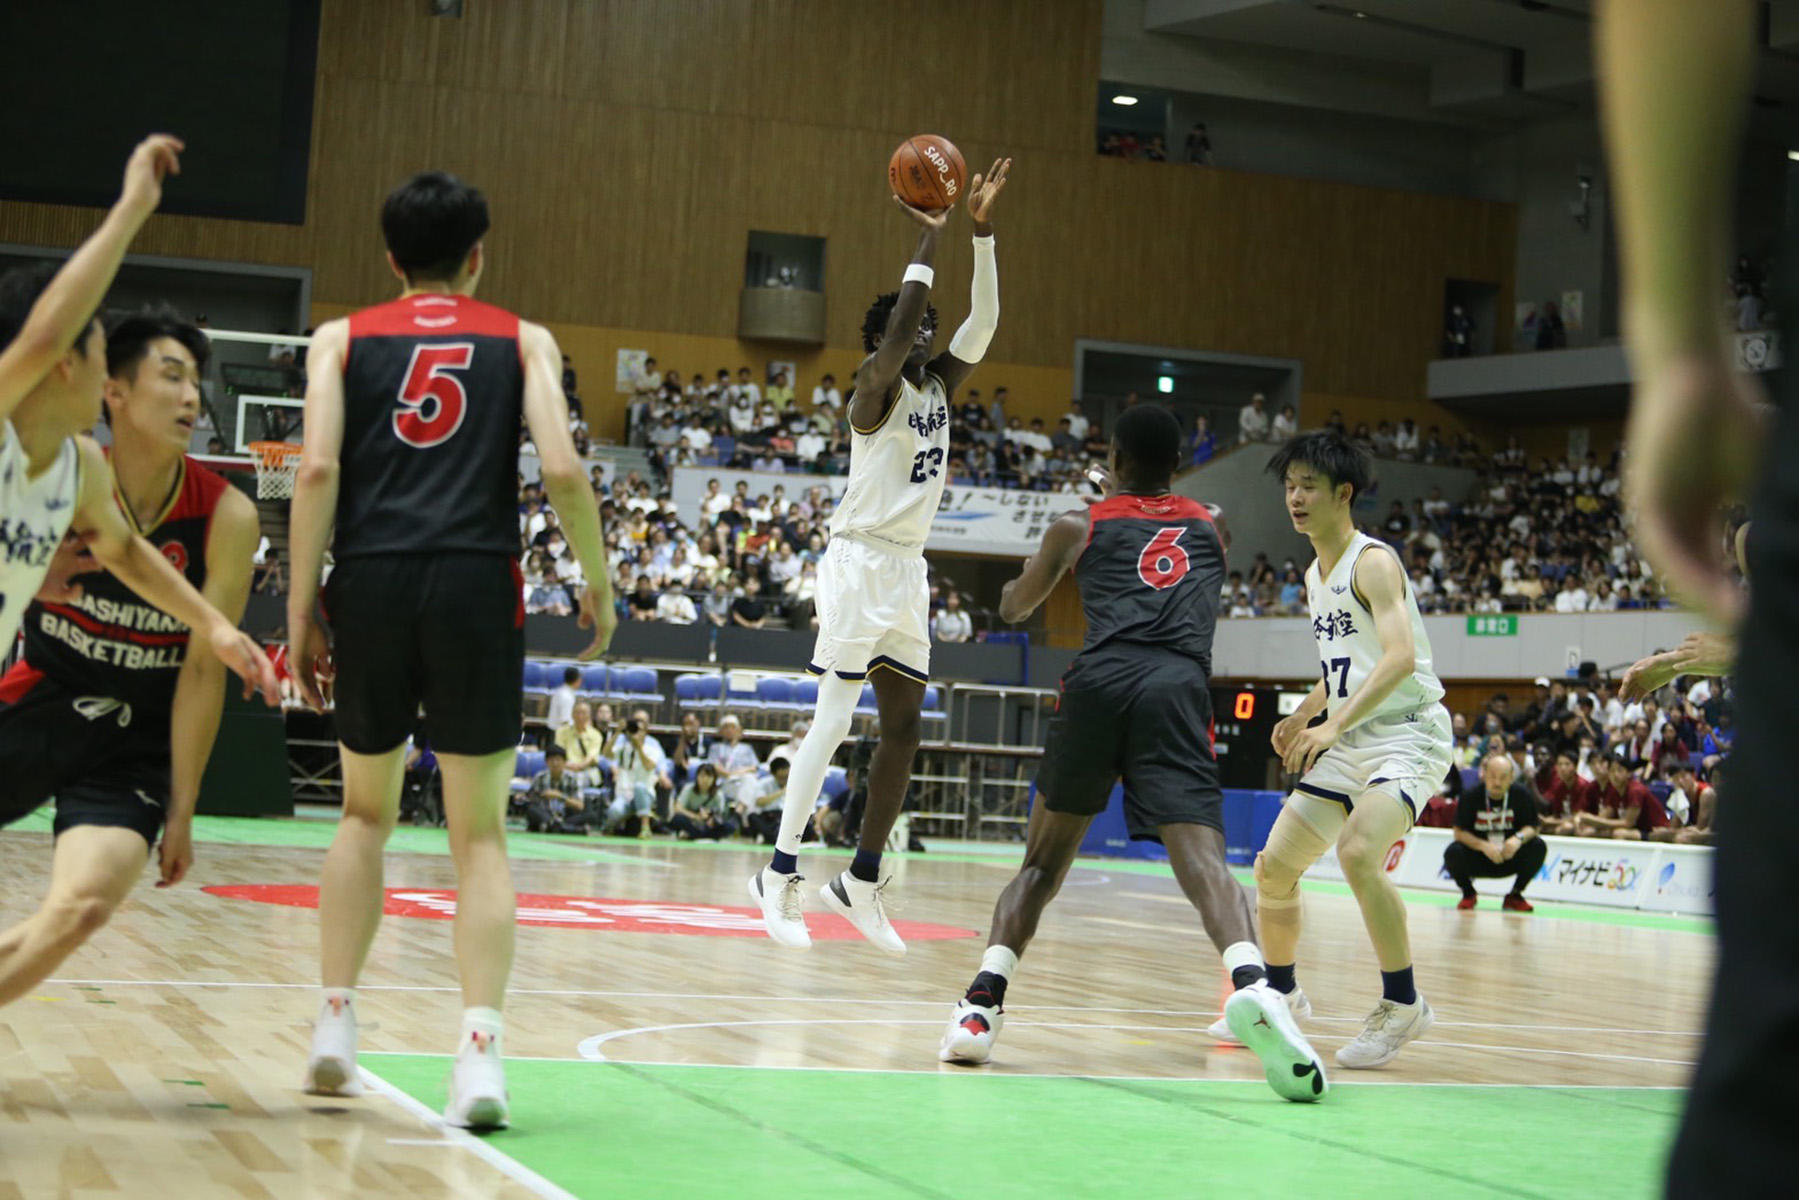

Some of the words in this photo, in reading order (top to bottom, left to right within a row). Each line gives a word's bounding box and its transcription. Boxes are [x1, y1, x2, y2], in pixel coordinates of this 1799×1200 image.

[392, 342, 475, 449] 5
[909, 447, 944, 483] 23
[1137, 526, 1190, 591] 6
[68, 594, 190, 632] ASHIYAM
[40, 613, 185, 670] BASKETBALL
[1234, 692, 1255, 719] 0
[1559, 859, 1611, 886] マイナビ
